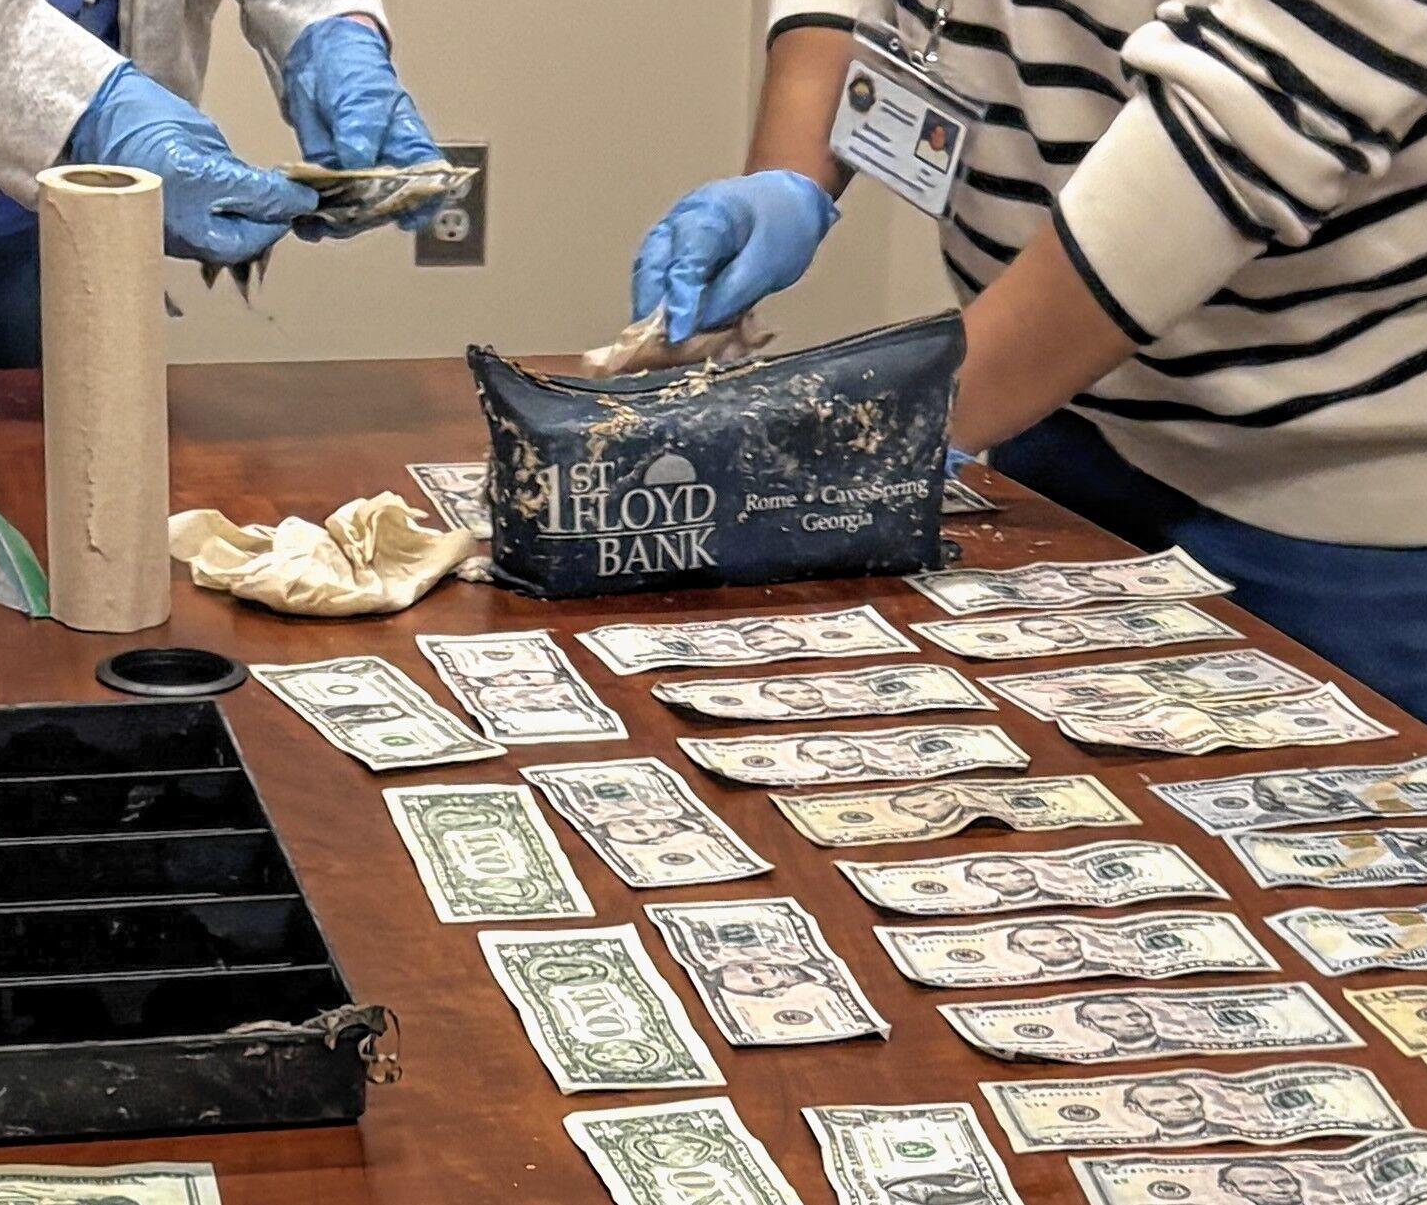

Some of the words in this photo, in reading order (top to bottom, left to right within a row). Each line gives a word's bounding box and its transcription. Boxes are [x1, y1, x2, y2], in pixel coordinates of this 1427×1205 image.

[569, 482, 718, 533] FLOYD
[745, 493, 798, 511] Rome
[822, 485, 873, 505] Cave
[870, 478, 930, 503] Spring
[801, 511, 874, 534] Georgia
[595, 526, 718, 578] BANK
